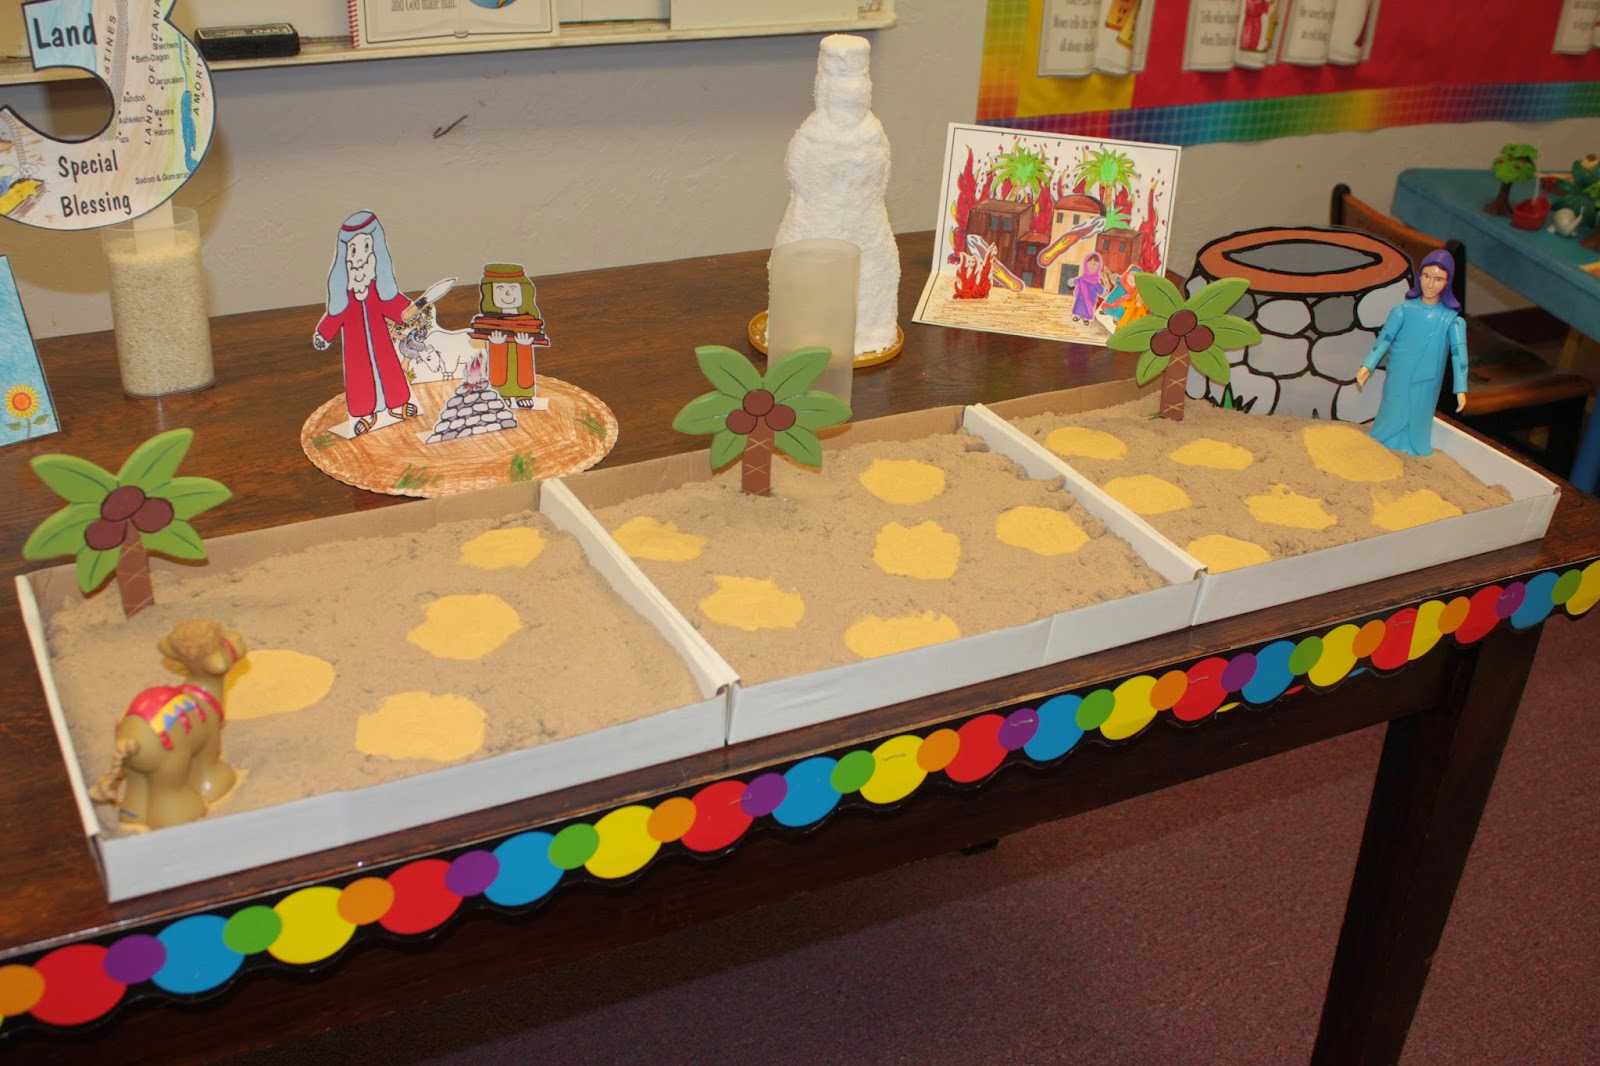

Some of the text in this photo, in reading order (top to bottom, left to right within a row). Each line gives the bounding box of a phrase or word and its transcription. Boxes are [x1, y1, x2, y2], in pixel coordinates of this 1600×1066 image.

[33, 13, 97, 49] Land
[135, 53, 170, 63] Beth-Dagon
[183, 40, 192, 68] Jordan
[148, 65, 157, 85] OF
[155, 76, 184, 86] Jerusalem
[123, 94, 145, 103] Ashdod
[58, 149, 119, 183] Special
[135, 176, 156, 185] Sodom
[60, 191, 132, 218] Blessing
